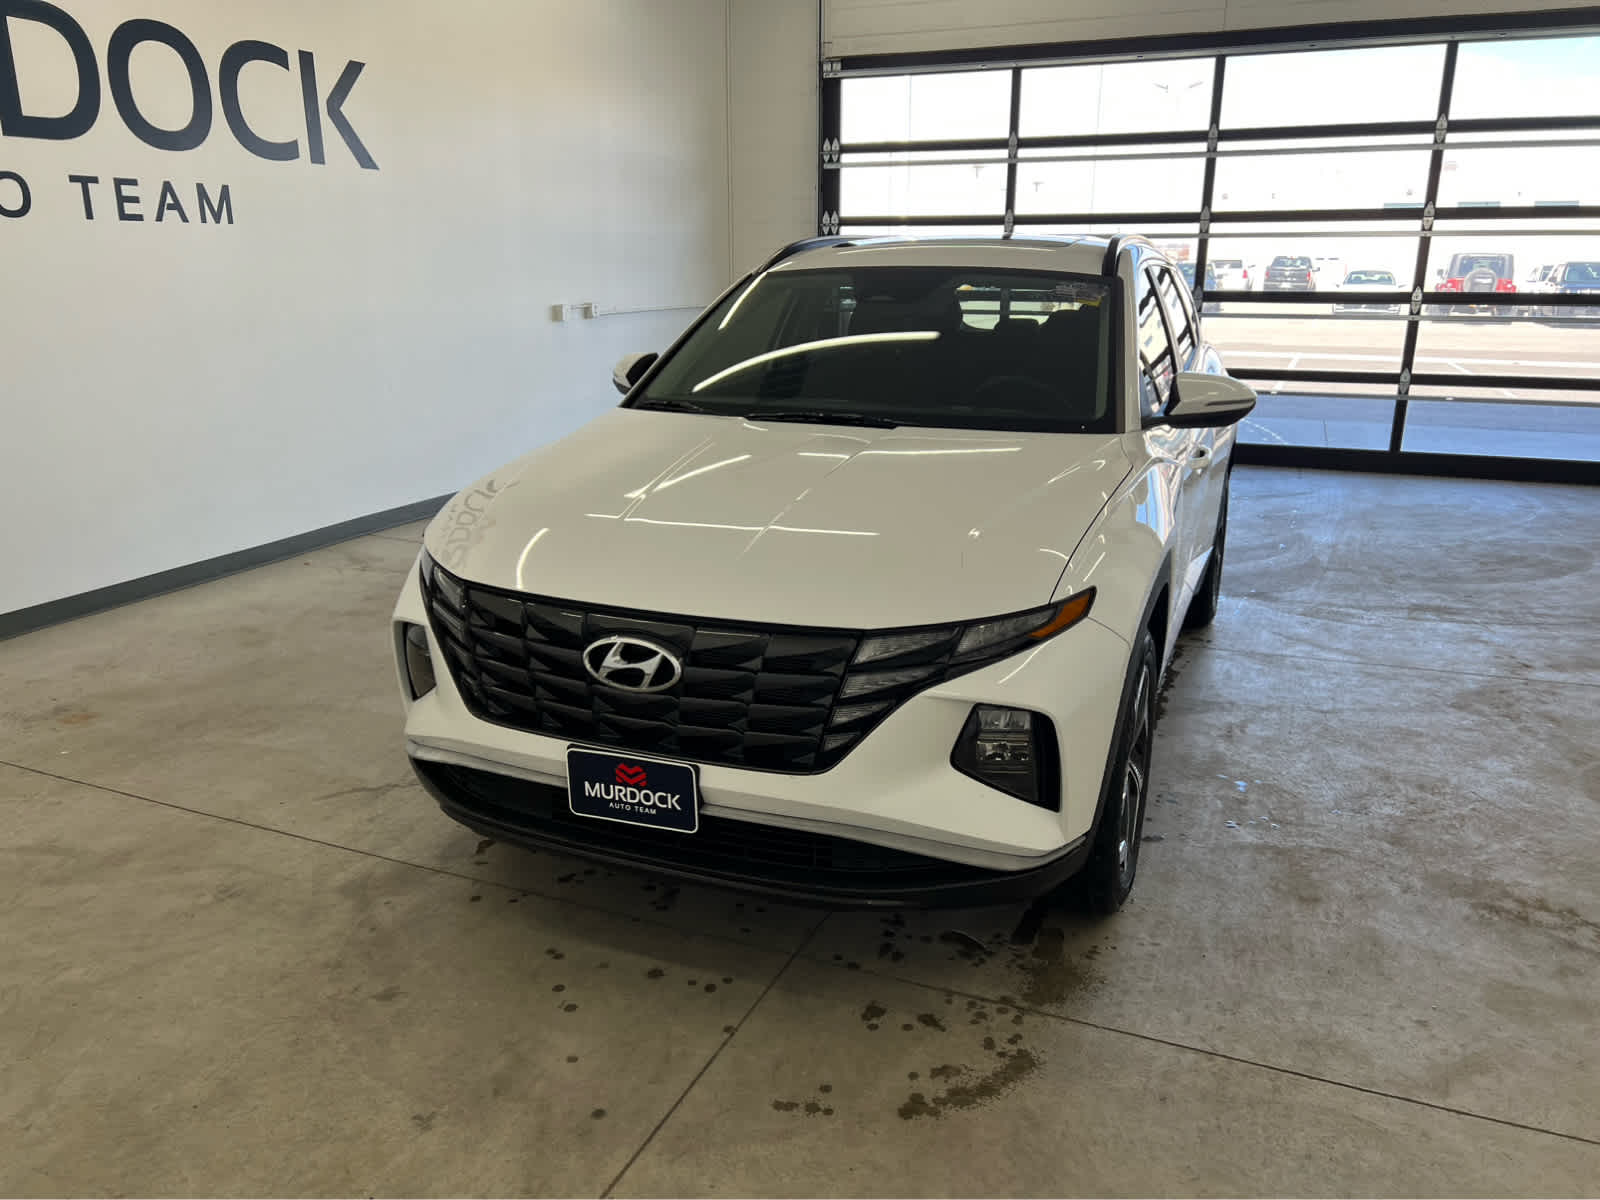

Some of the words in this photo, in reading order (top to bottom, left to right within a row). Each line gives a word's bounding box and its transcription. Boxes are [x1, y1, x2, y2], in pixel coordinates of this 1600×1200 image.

[0, 0, 380, 170] DOCK
[68, 174, 234, 225] TEAM
[584, 781, 681, 810] MURDOCK
[609, 802, 631, 811] AUTO
[634, 806, 657, 815] TEAM
